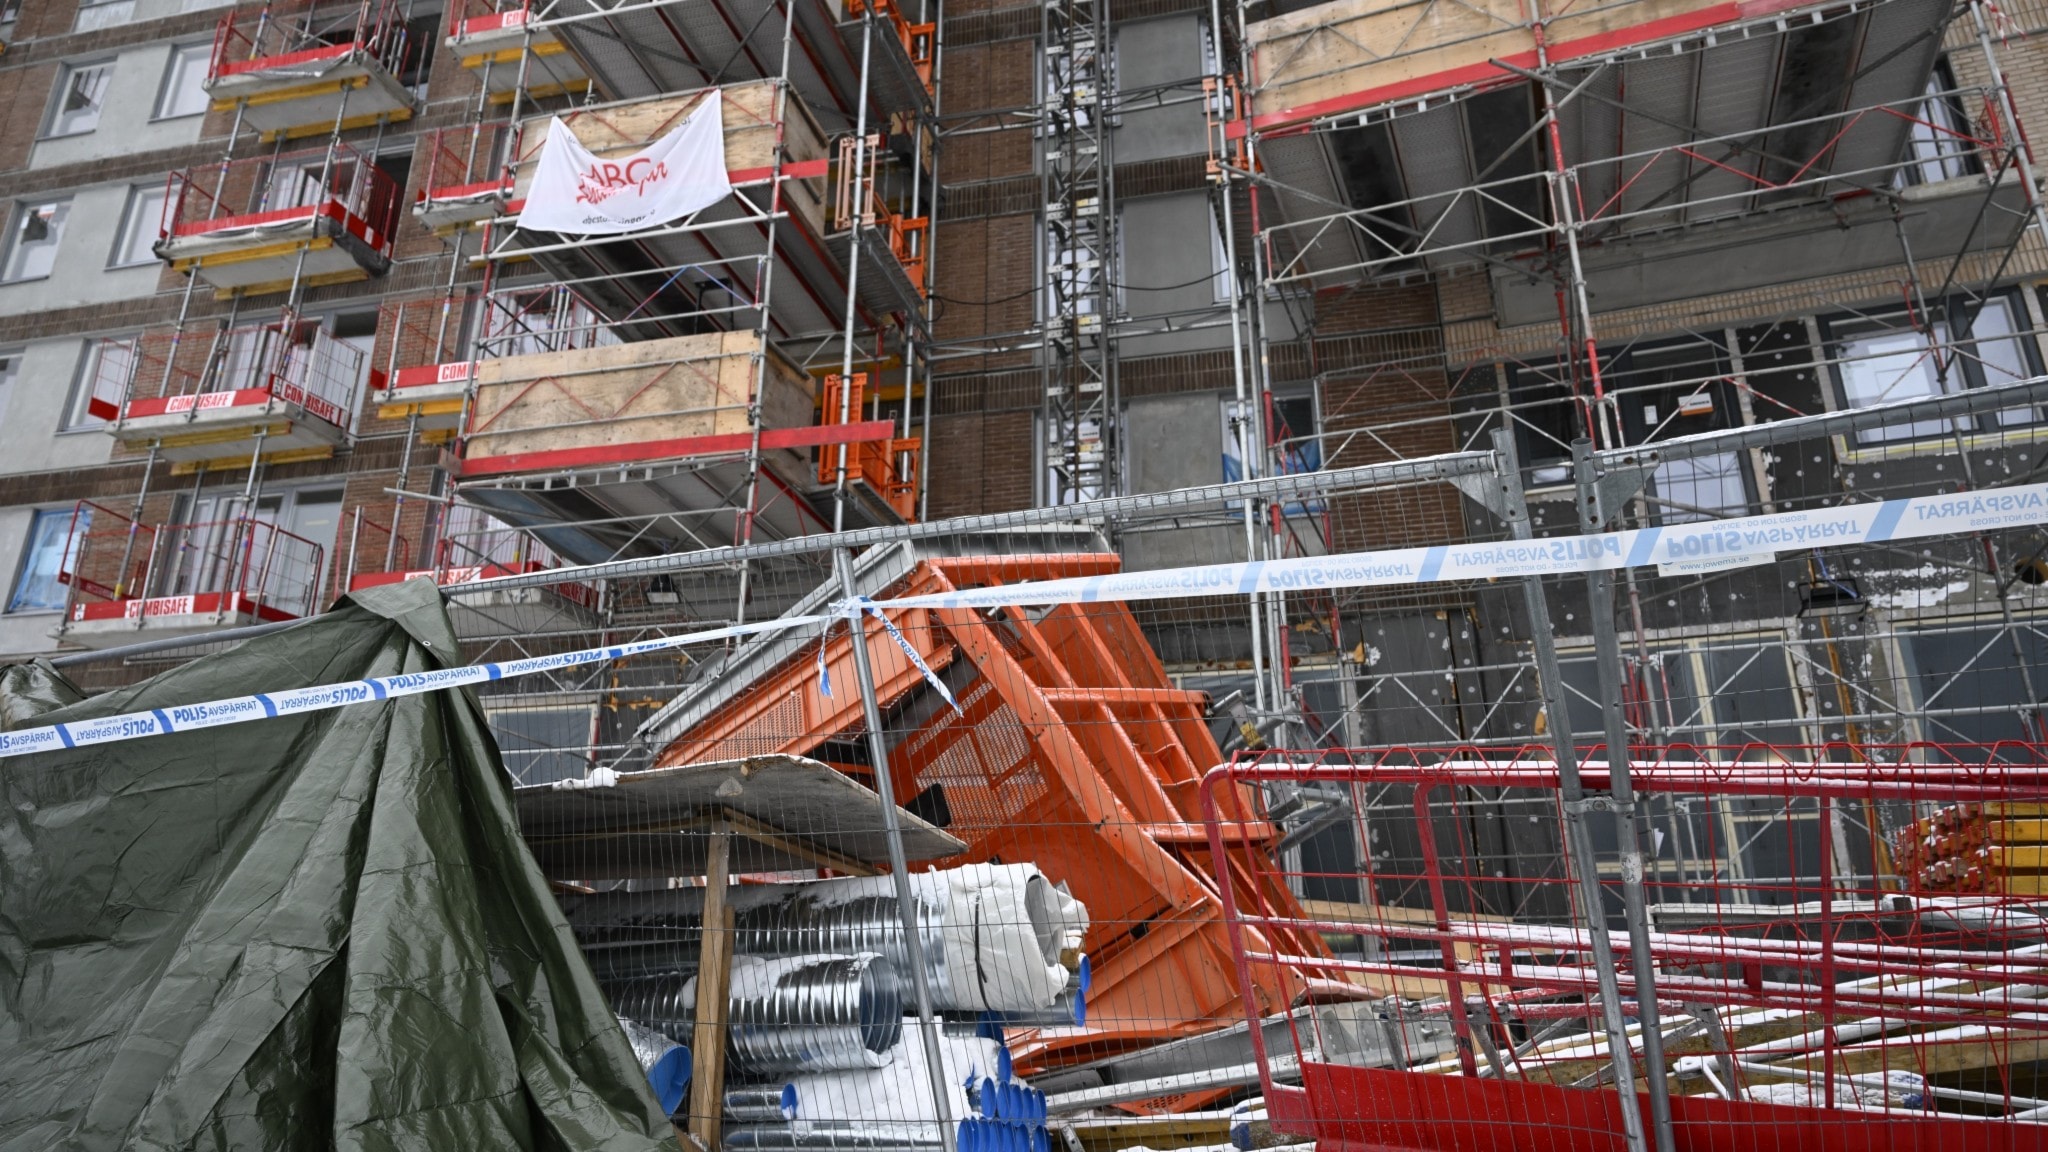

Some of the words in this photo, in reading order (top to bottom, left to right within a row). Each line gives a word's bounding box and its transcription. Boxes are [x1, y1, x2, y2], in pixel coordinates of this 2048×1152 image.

[387, 673, 426, 690] POLIS
[331, 685, 367, 704] POLIS
[173, 705, 208, 723] POLIS
[123, 718, 154, 736] POLIS
